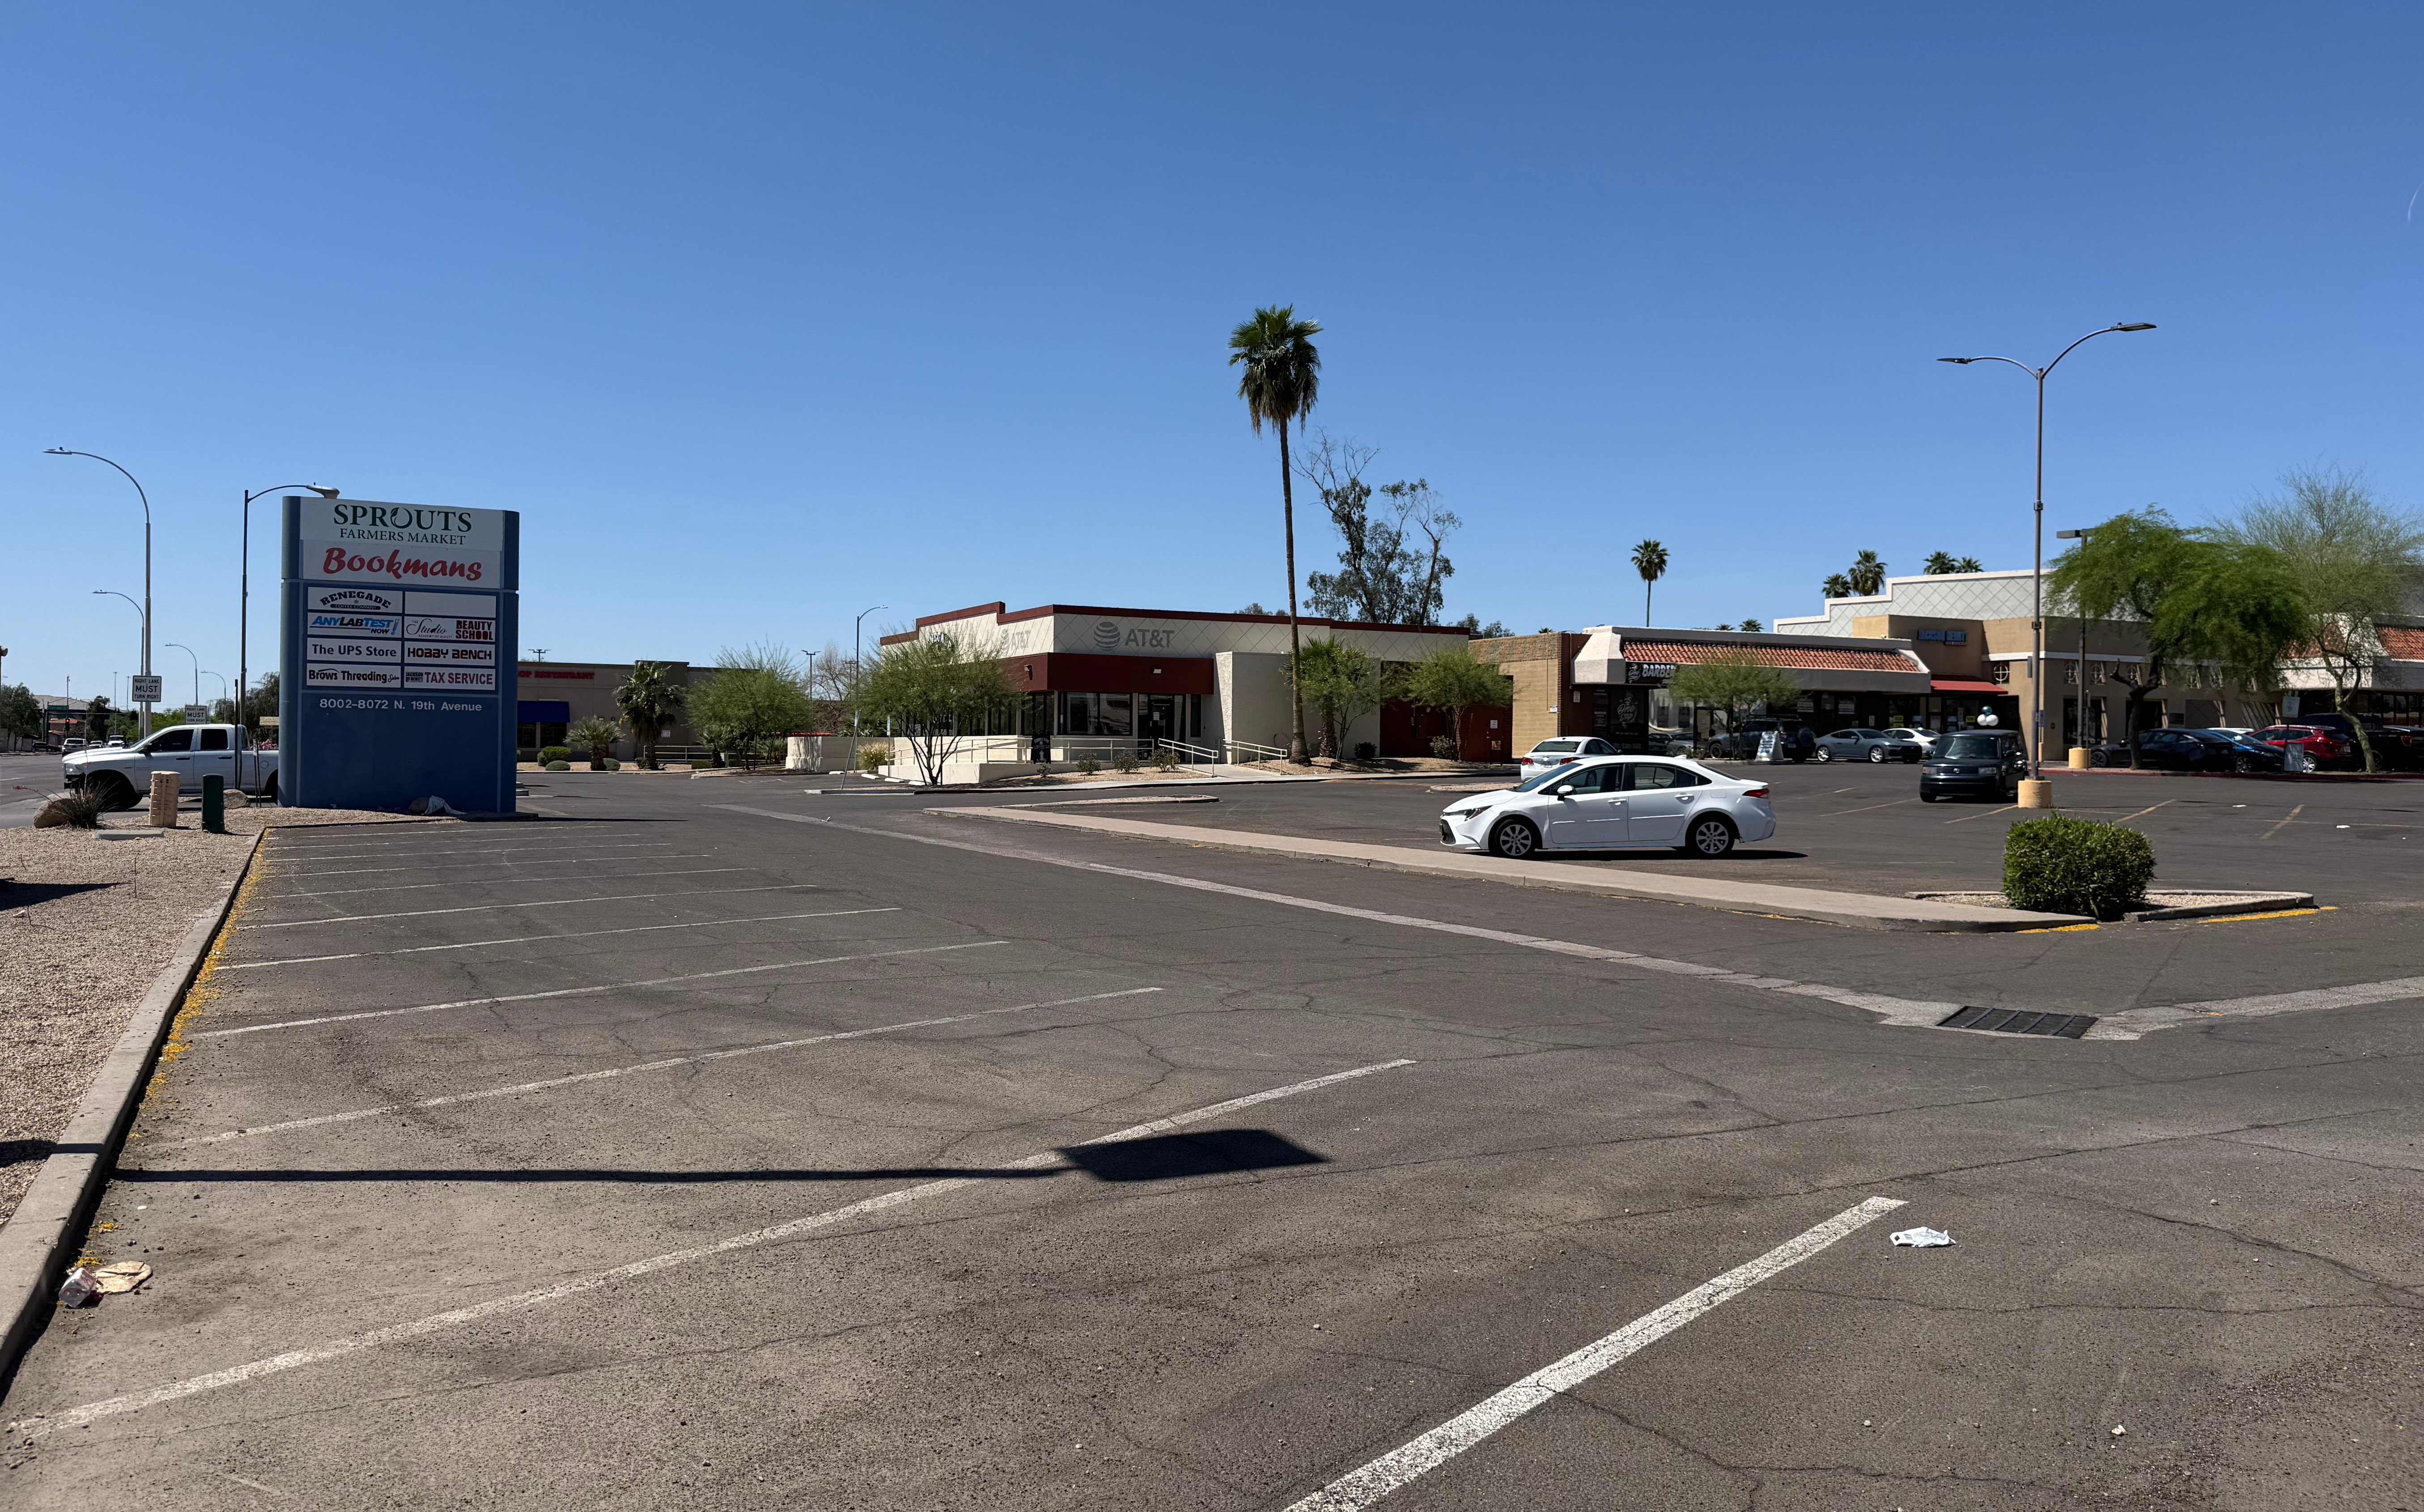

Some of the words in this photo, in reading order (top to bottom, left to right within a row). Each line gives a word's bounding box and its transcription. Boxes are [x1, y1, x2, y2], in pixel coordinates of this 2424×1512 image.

[334, 504, 472, 532] SPROUTS
[340, 528, 403, 541] FARMERS
[407, 532, 466, 545] MARKET
[323, 547, 482, 581] Bookmans
[320, 591, 391, 608] RENEGADE
[406, 618, 447, 635] Studio
[456, 620, 492, 631] BEAUTY
[455, 630, 493, 640] SCHOOL
[1011, 629, 1031, 650] AT&T
[1124, 628, 1175, 648] AT&T
[312, 644, 334, 654] The
[338, 645, 362, 656] UPS
[365, 646, 397, 657] Store
[408, 647, 449, 658] HOBBY
[309, 669, 339, 680] Brows
[341, 671, 387, 684] Threading
[425, 672, 446, 684] TAX
[448, 672, 493, 684] SERVICE
[319, 699, 389, 709] 8002-8072
[394, 700, 405, 709] N.
[411, 701, 435, 710] 19th
[441, 702, 482, 711] Avenue
